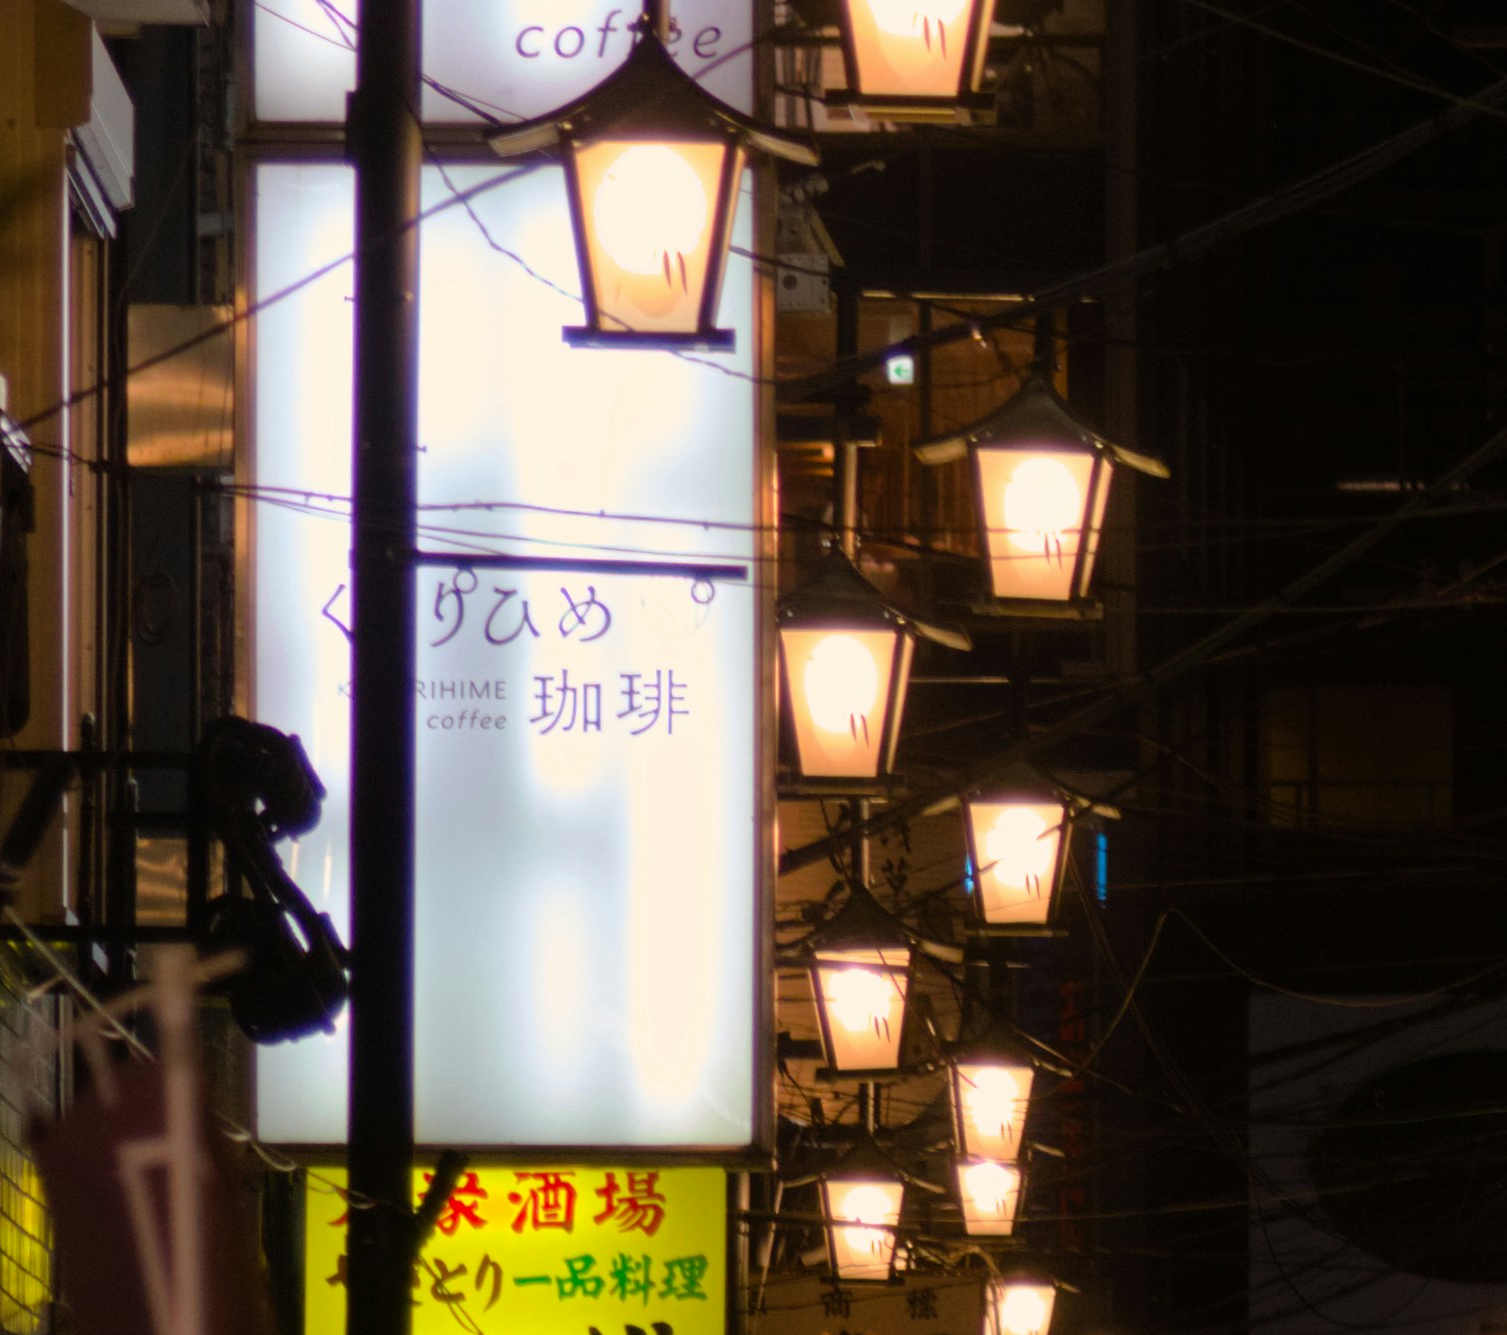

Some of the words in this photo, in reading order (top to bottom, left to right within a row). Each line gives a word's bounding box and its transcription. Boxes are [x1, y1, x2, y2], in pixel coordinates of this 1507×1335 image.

[322, 583, 612, 647] くりひめ
[427, 710, 507, 730] coffee
[529, 669, 689, 735] 珈琲
